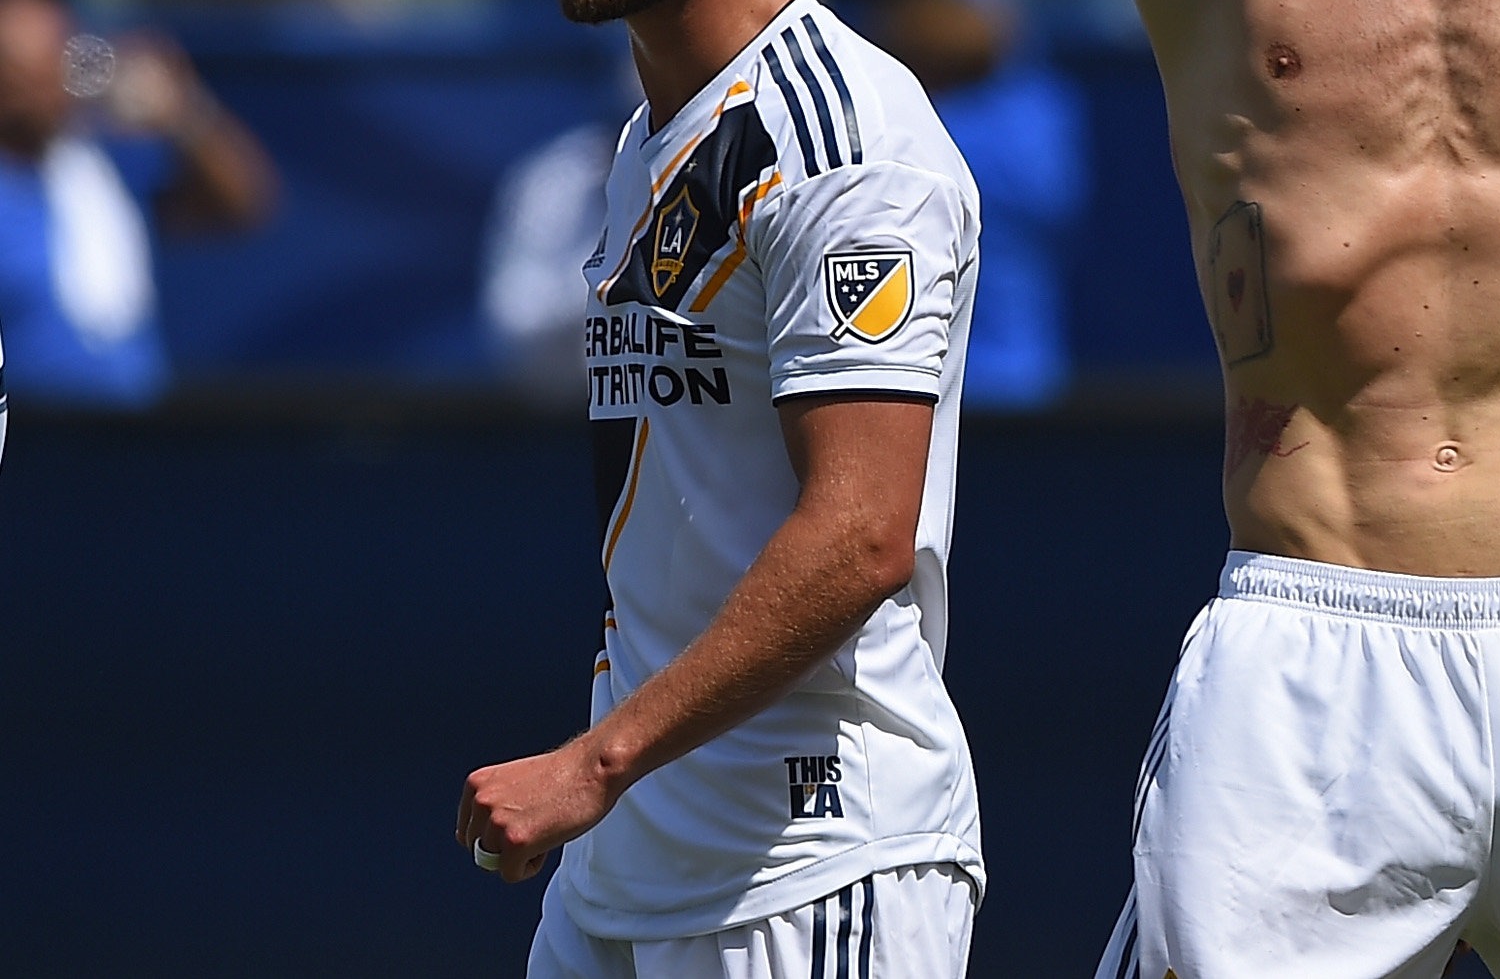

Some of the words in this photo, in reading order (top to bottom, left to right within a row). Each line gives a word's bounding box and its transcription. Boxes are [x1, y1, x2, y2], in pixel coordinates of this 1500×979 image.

[660, 226, 682, 254] LA
[835, 261, 880, 281] MLS
[783, 755, 842, 784] THIS
[790, 783, 844, 819] LA
